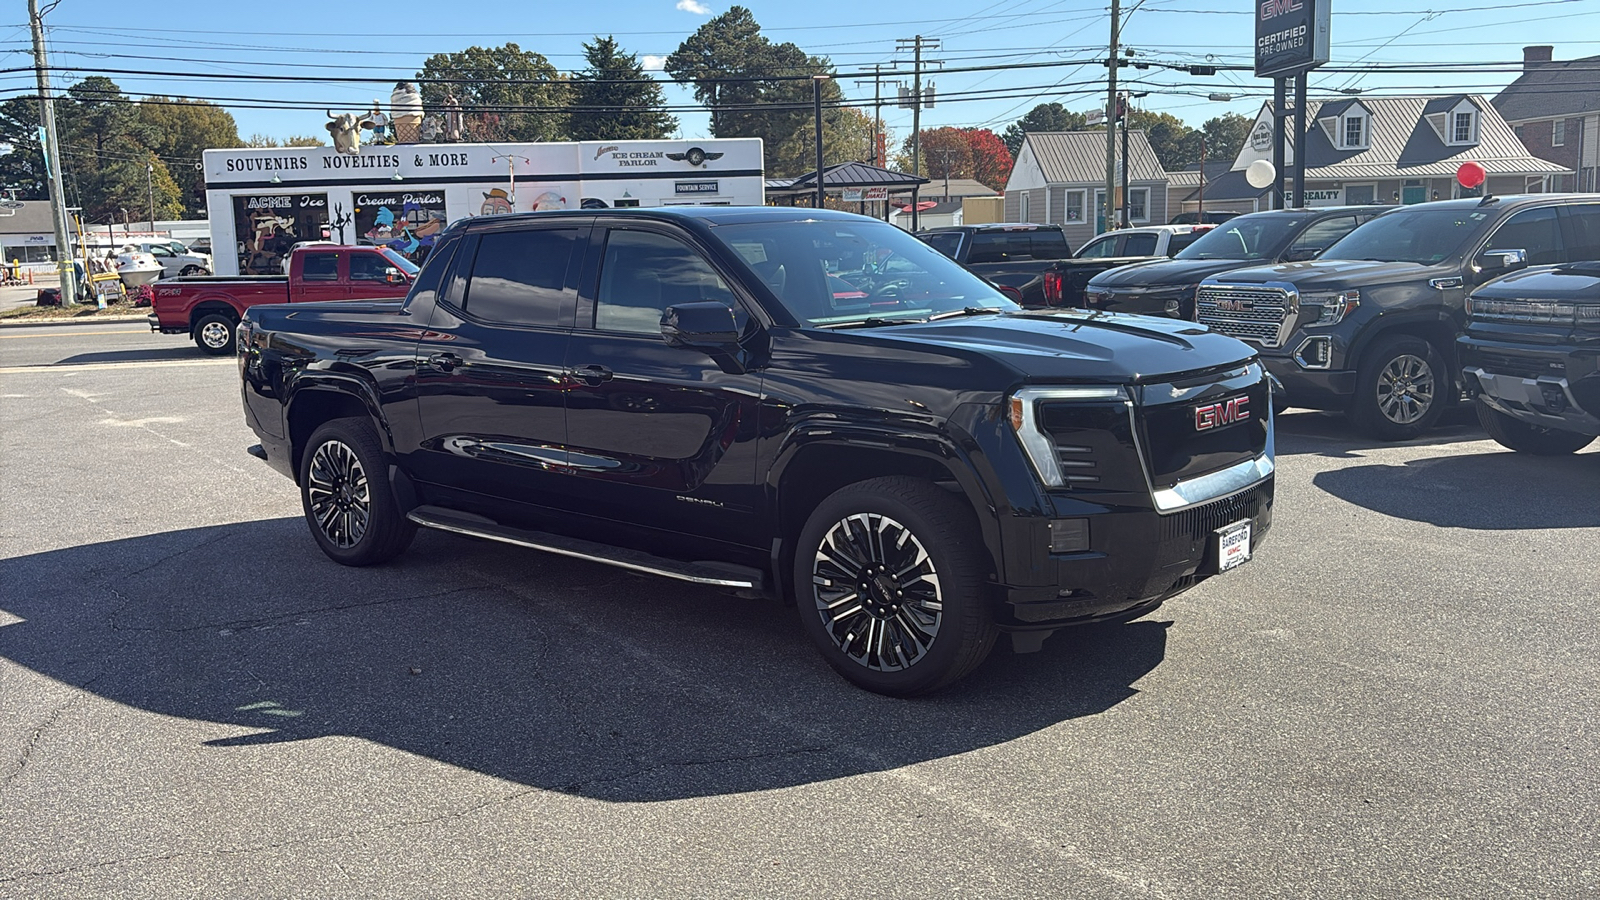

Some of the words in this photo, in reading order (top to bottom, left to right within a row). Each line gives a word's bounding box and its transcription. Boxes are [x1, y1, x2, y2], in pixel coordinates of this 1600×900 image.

[1261, 0, 1303, 21] GMC
[1258, 25, 1306, 47] CERTIFIED
[1260, 37, 1304, 57] PRE-OWNED
[227, 157, 308, 172] SOUVENIRS
[323, 154, 400, 169] NOVELTIES
[414, 155, 424, 167] &
[429, 153, 468, 167] MORE
[619, 159, 657, 167] PARLOR
[676, 184, 698, 192] FOUNTAIN
[699, 183, 717, 191] SERVICE
[248, 197, 291, 208] ACME
[299, 196, 325, 208] Ice
[357, 194, 397, 206] Cream
[402, 193, 442, 205] Parlor
[1304, 191, 1339, 200] REALTY
[1217, 299, 1253, 312] GMC
[1195, 396, 1250, 431] GMC
[676, 495, 724, 507] DENALI
[1222, 530, 1248, 550] BAREFORD
[1227, 545, 1242, 556] GMC
